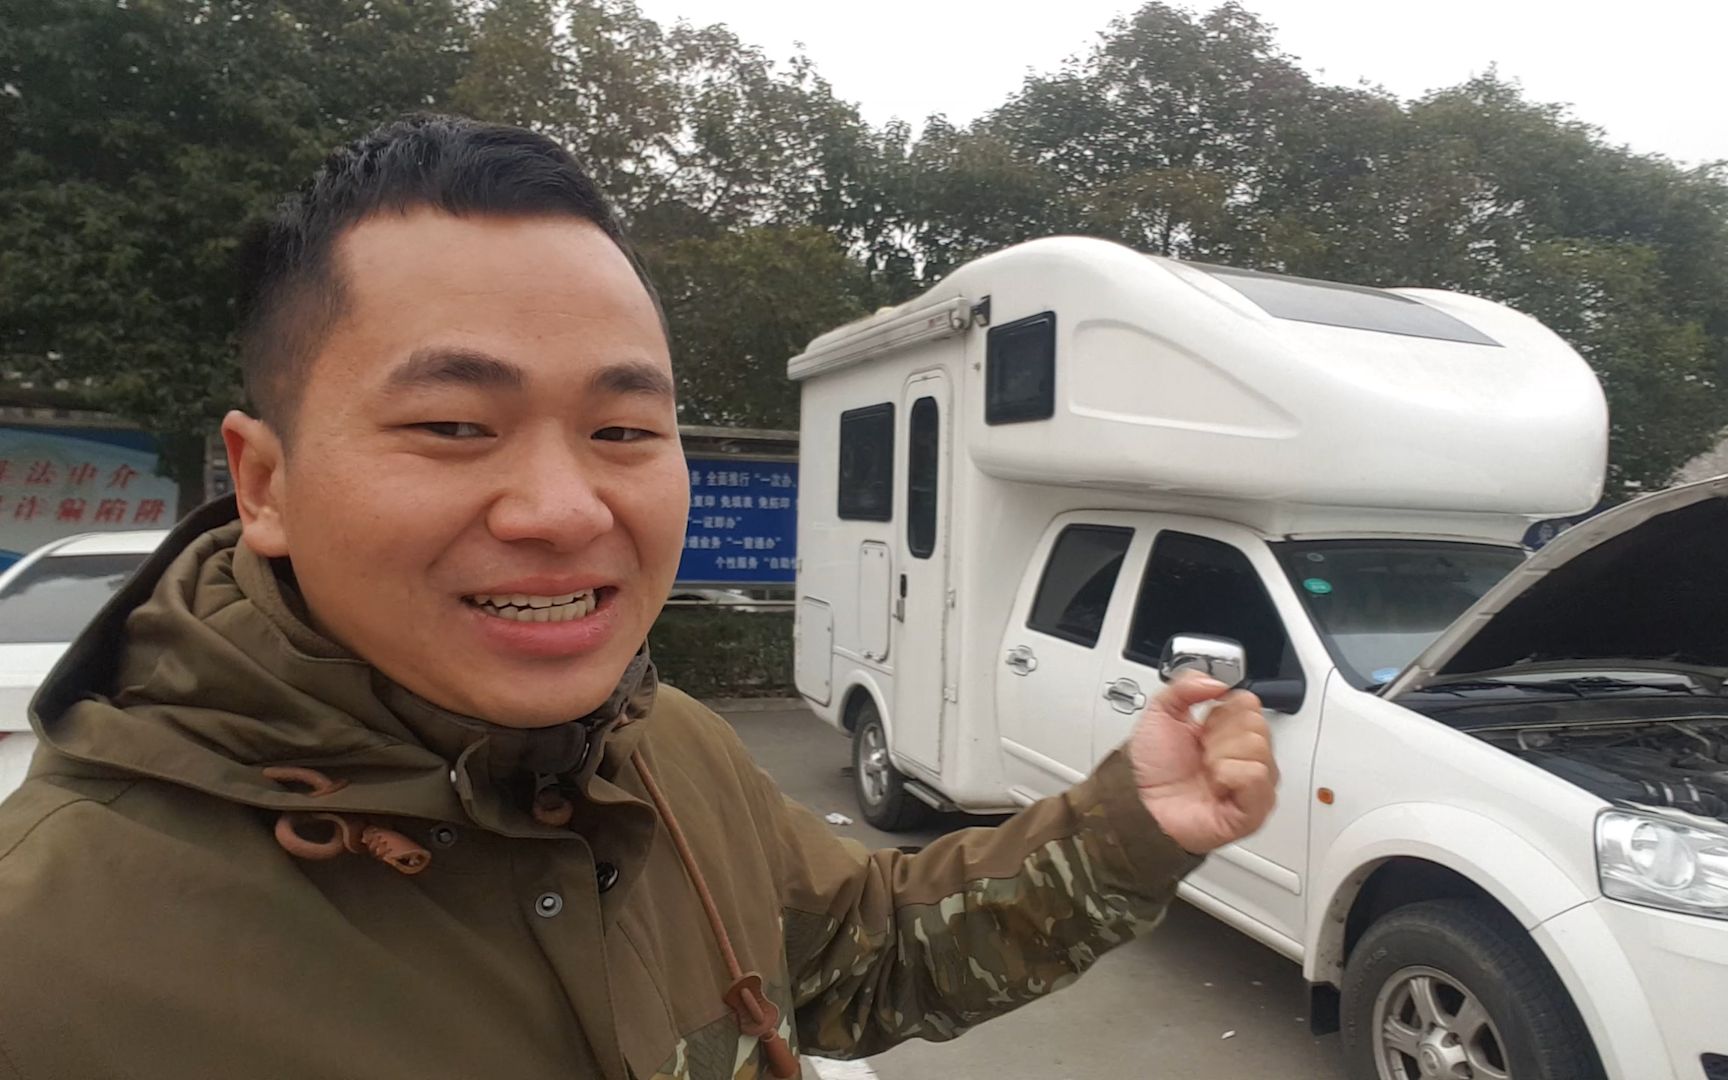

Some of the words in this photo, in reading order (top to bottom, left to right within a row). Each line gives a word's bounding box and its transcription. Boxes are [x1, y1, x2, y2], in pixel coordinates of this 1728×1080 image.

[0, 459, 139, 488] 法中介
[690, 495, 716, 508] 复印
[0, 495, 166, 525] 诈骗陷阱
[685, 536, 721, 549] 通业务
[715, 556, 758, 570] 个性服务
